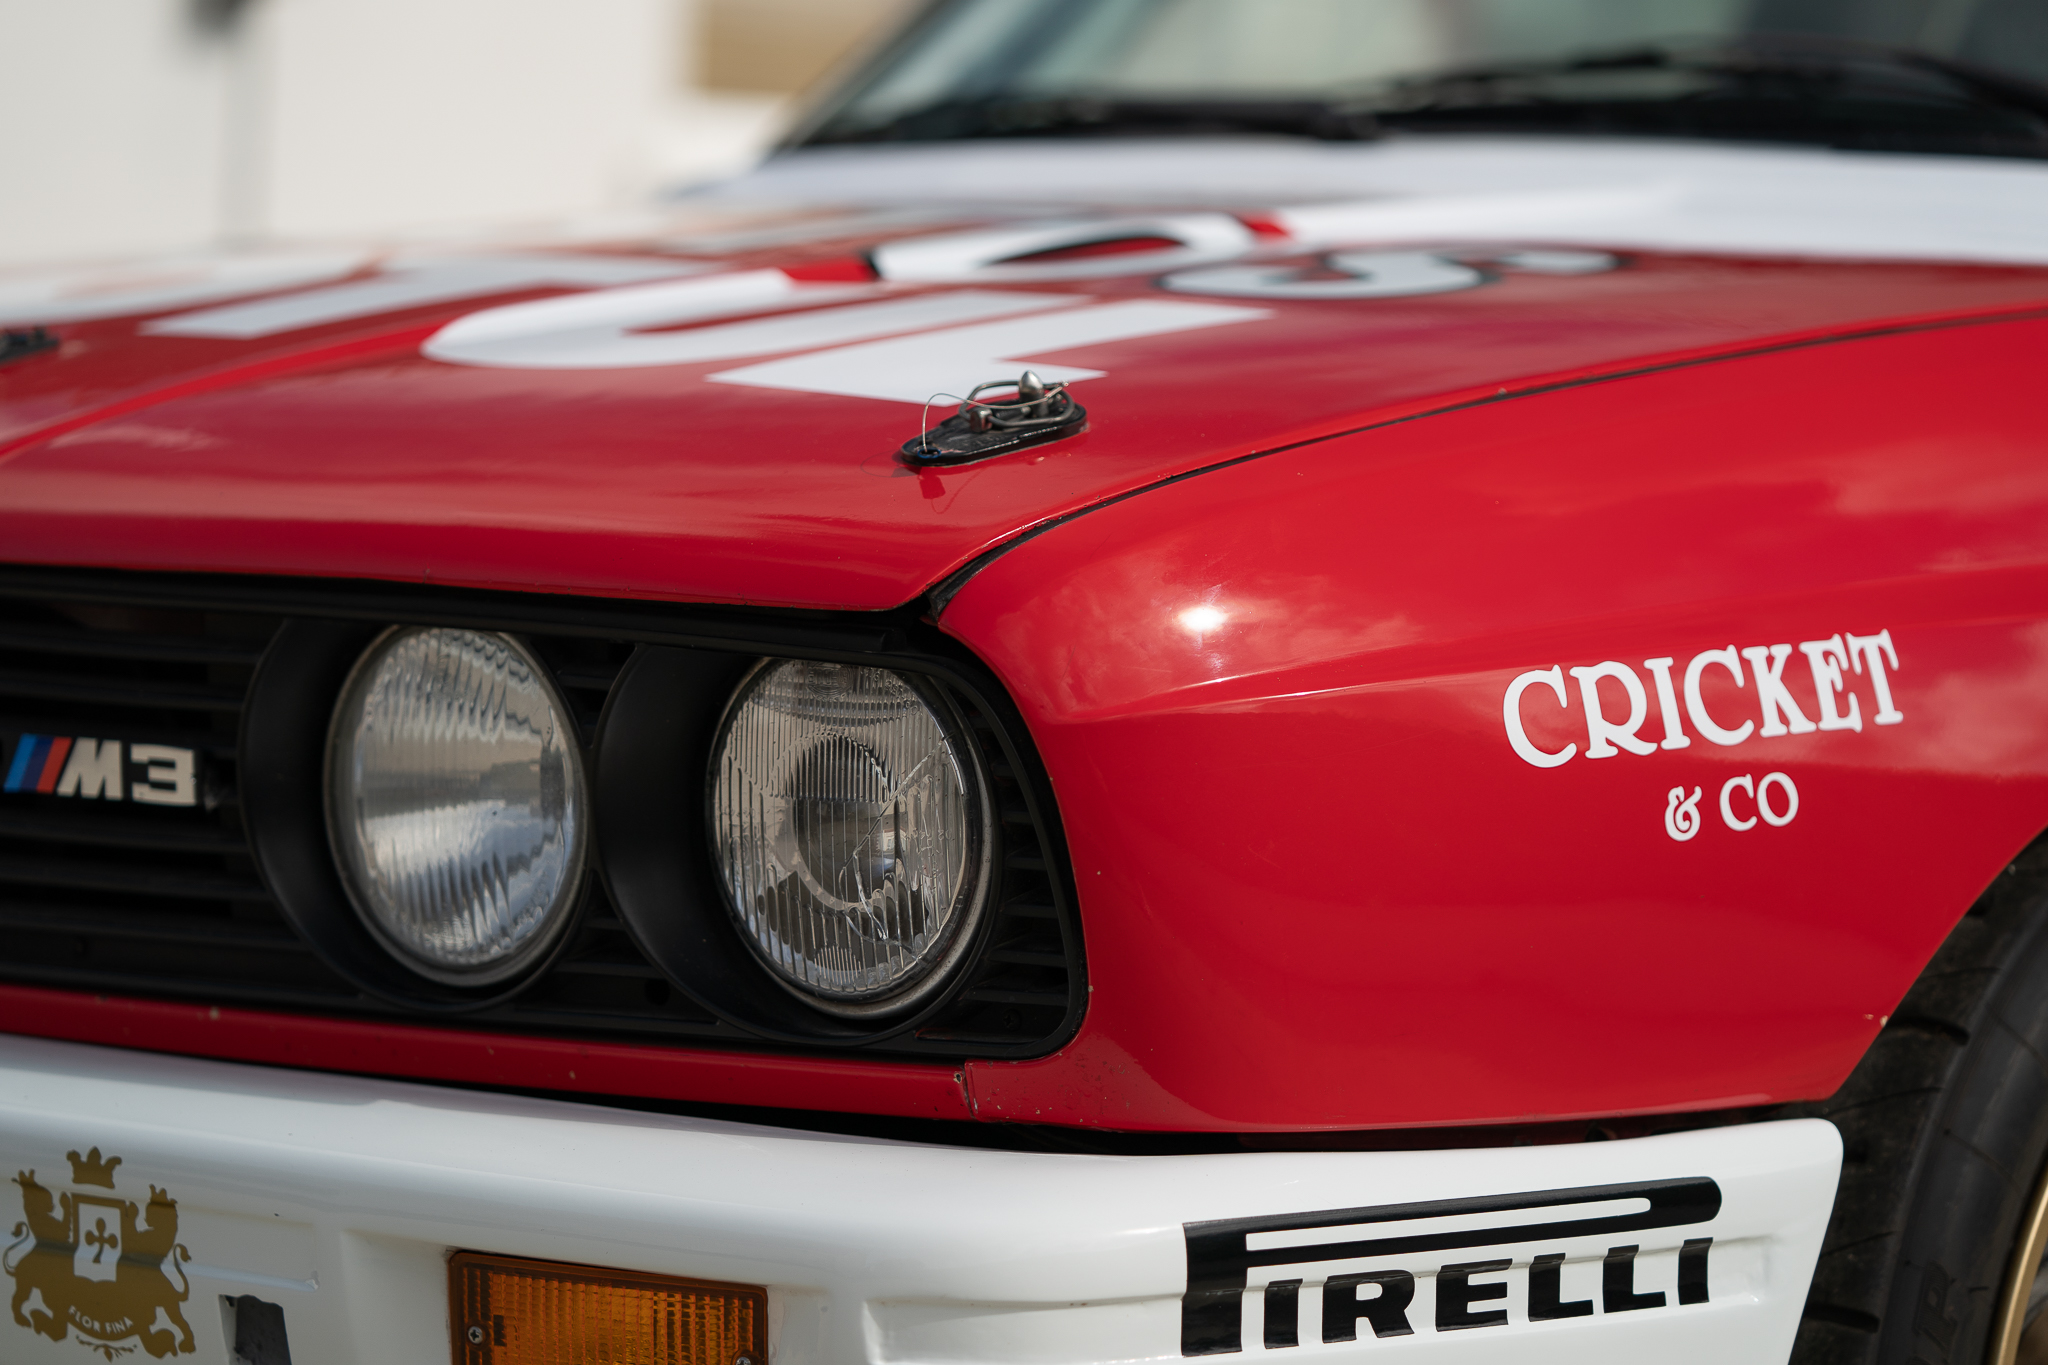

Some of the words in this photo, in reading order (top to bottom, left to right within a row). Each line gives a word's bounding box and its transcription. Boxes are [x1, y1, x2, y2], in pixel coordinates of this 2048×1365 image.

[1503, 628, 1904, 769] CRICKET
[56, 736, 197, 807] M3
[1664, 785, 1703, 842] &
[1718, 771, 1800, 832] CO
[1181, 1175, 1723, 1357] PIRELLI
[68, 1304, 101, 1334] FLOR
[104, 1315, 134, 1335] FINA
